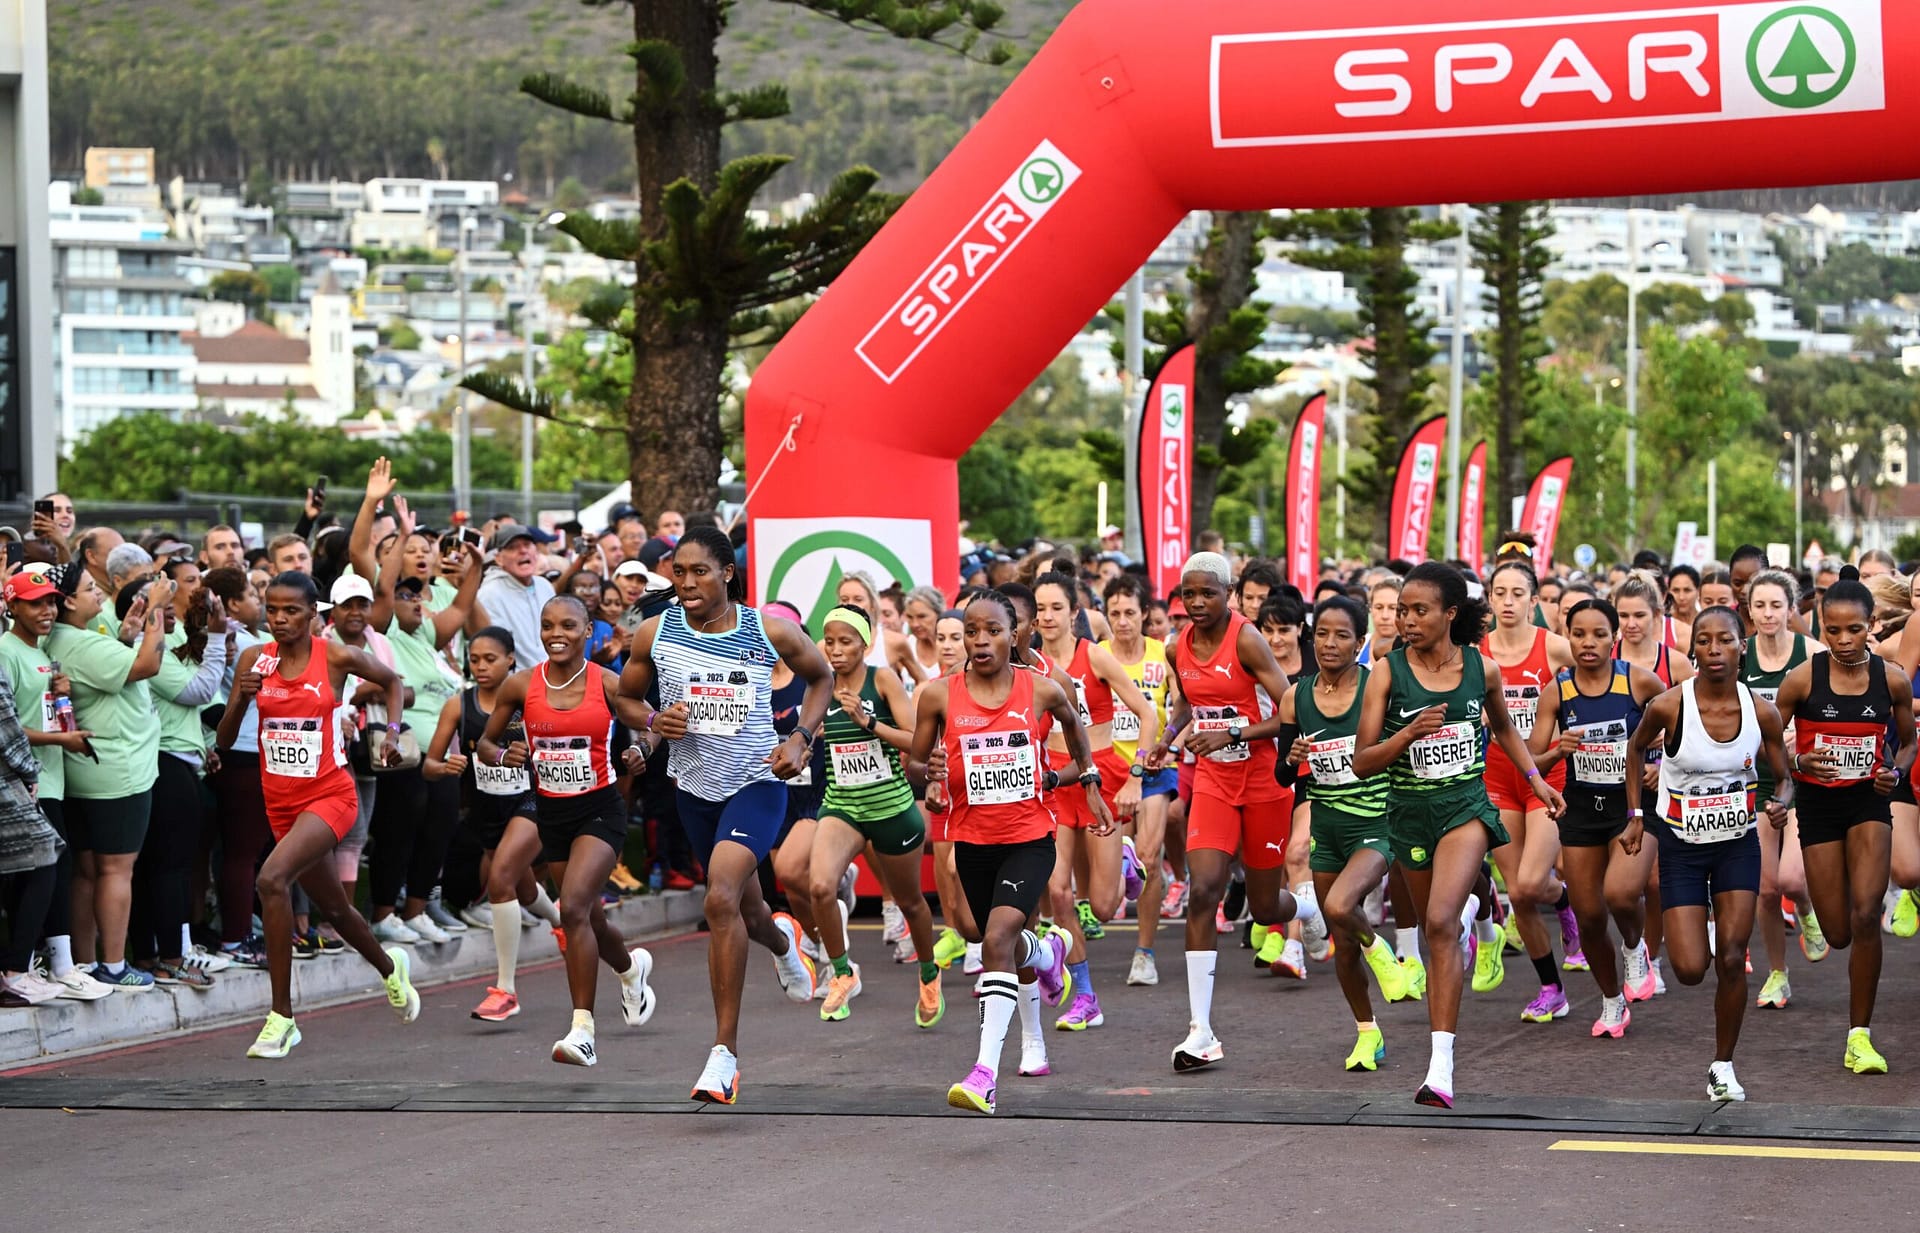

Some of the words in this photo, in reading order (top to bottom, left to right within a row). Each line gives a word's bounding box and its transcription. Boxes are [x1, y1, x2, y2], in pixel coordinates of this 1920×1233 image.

[1334, 30, 1711, 118] SPAR
[900, 202, 1025, 336] SPAR
[1163, 439, 1181, 568] SPAR
[707, 672, 724, 682] 2025
[730, 672, 746, 681] ASA
[1144, 663, 1164, 683] 50
[700, 687, 734, 697] SPAR
[1505, 690, 1519, 698] 2025
[1507, 700, 1528, 708] PAR
[687, 701, 717, 720] MOGADI
[719, 703, 749, 723] CASTER
[282, 721, 298, 731] 2025
[1510, 712, 1537, 729] NTH
[273, 731, 303, 741] SPAR
[1588, 728, 1604, 738] 2025
[985, 737, 1004, 748] 2025
[1010, 733, 1026, 742] ASA
[1317, 739, 1346, 752] SPAR
[1831, 738, 1862, 746] SPAR
[270, 745, 309, 764] LEBO
[840, 744, 868, 753] SPAR
[1412, 739, 1474, 767] MESERET
[544, 752, 575, 761] SPAR
[981, 753, 1016, 764] SPAR
[840, 755, 880, 775] ANNA
[1576, 755, 1626, 773] YANDISWA
[969, 765, 1034, 791] GLENROSE
[1697, 796, 1730, 808] SPAR
[1685, 809, 1748, 833] KARABO
